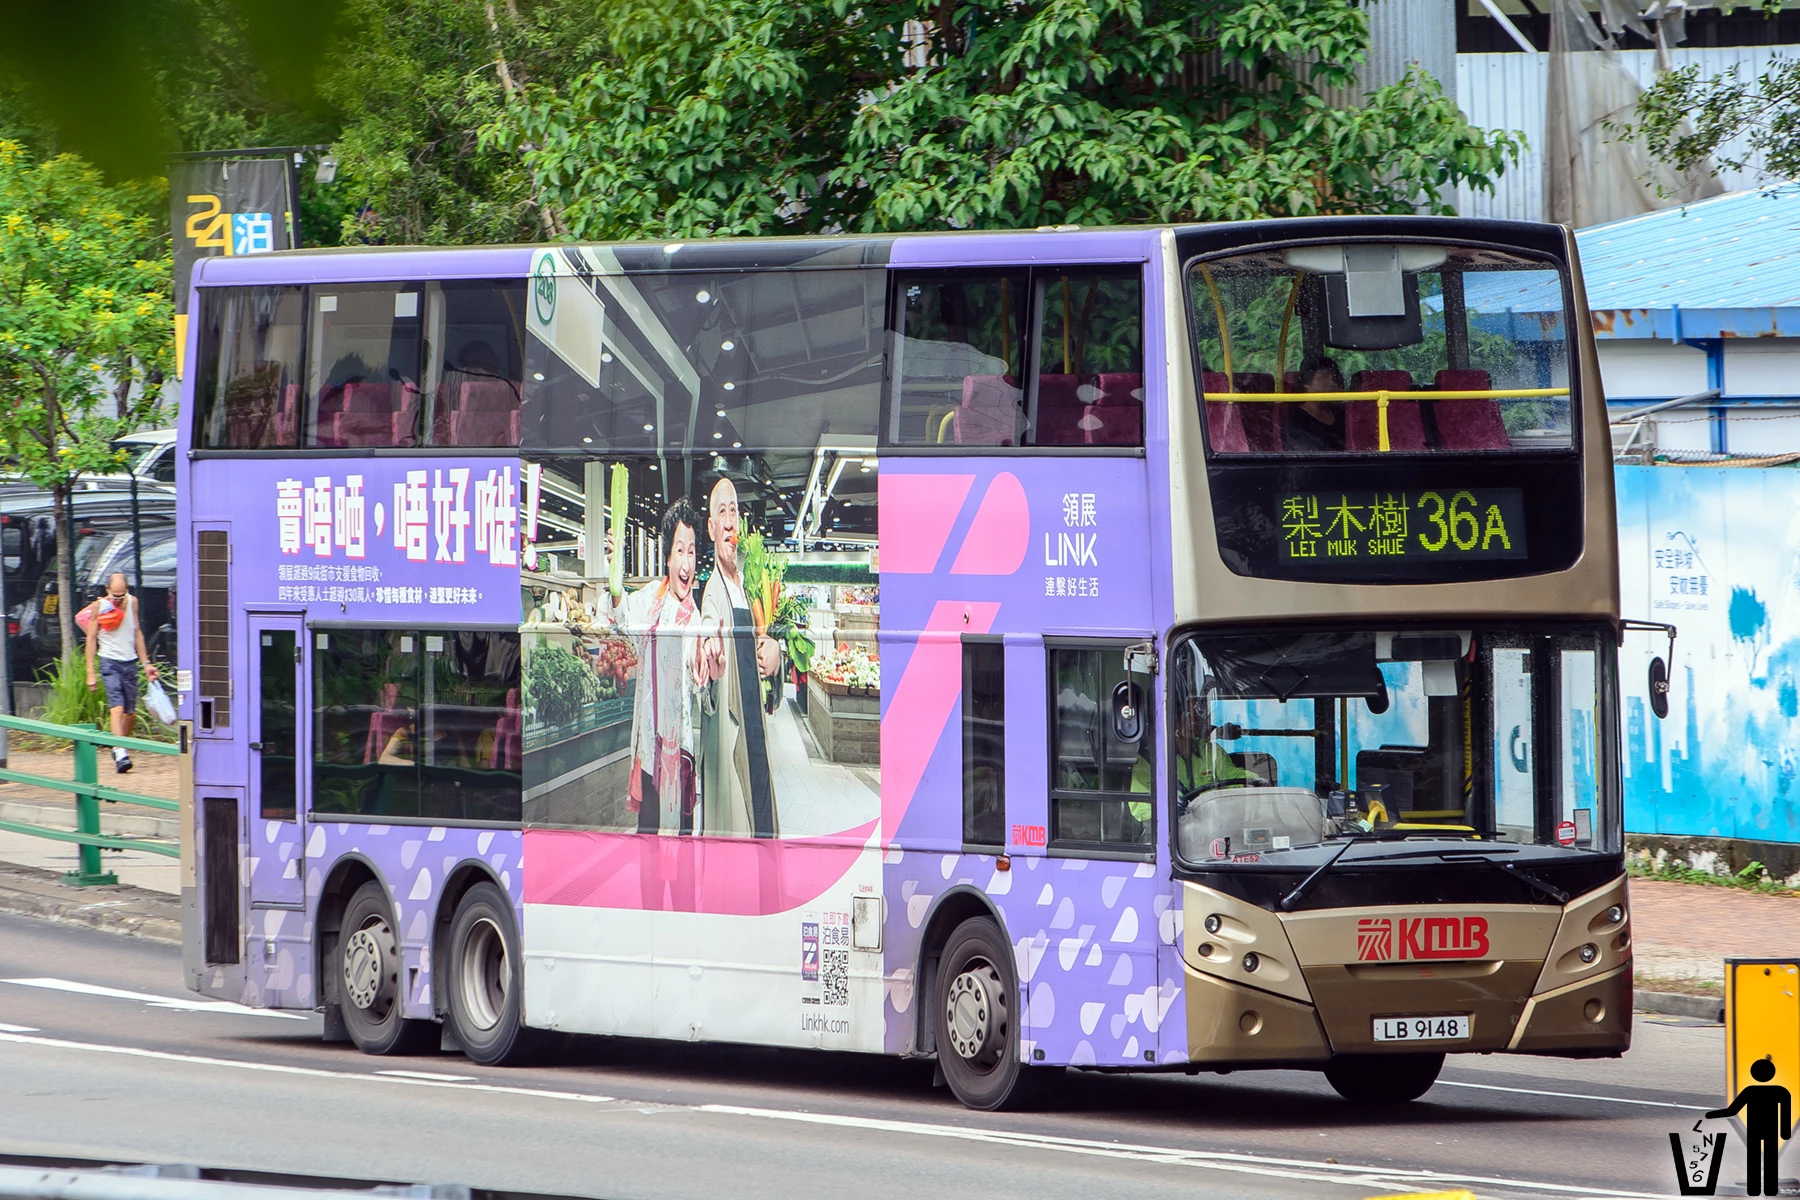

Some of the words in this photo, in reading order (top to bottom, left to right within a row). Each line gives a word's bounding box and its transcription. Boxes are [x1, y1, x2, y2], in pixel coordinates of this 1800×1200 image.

[1062, 493, 1097, 527] 領展
[1282, 493, 1410, 540] 梨木樹
[1417, 490, 1511, 552] 36A
[1045, 532, 1098, 567] LINK
[1290, 540, 1317, 557] LEI
[1327, 540, 1357, 556] MUK
[1368, 538, 1405, 555] SHUE
[1021, 825, 1047, 847] KMB
[1214, 843, 1225, 857] L
[1232, 854, 1260, 864] ATE52
[822, 926, 849, 946] 泊食易
[1398, 916, 1490, 960] KMB
[801, 1013, 850, 1034] Linkhk.com
[1384, 1021, 1408, 1039] LB
[1415, 1019, 1459, 1038] 9148
